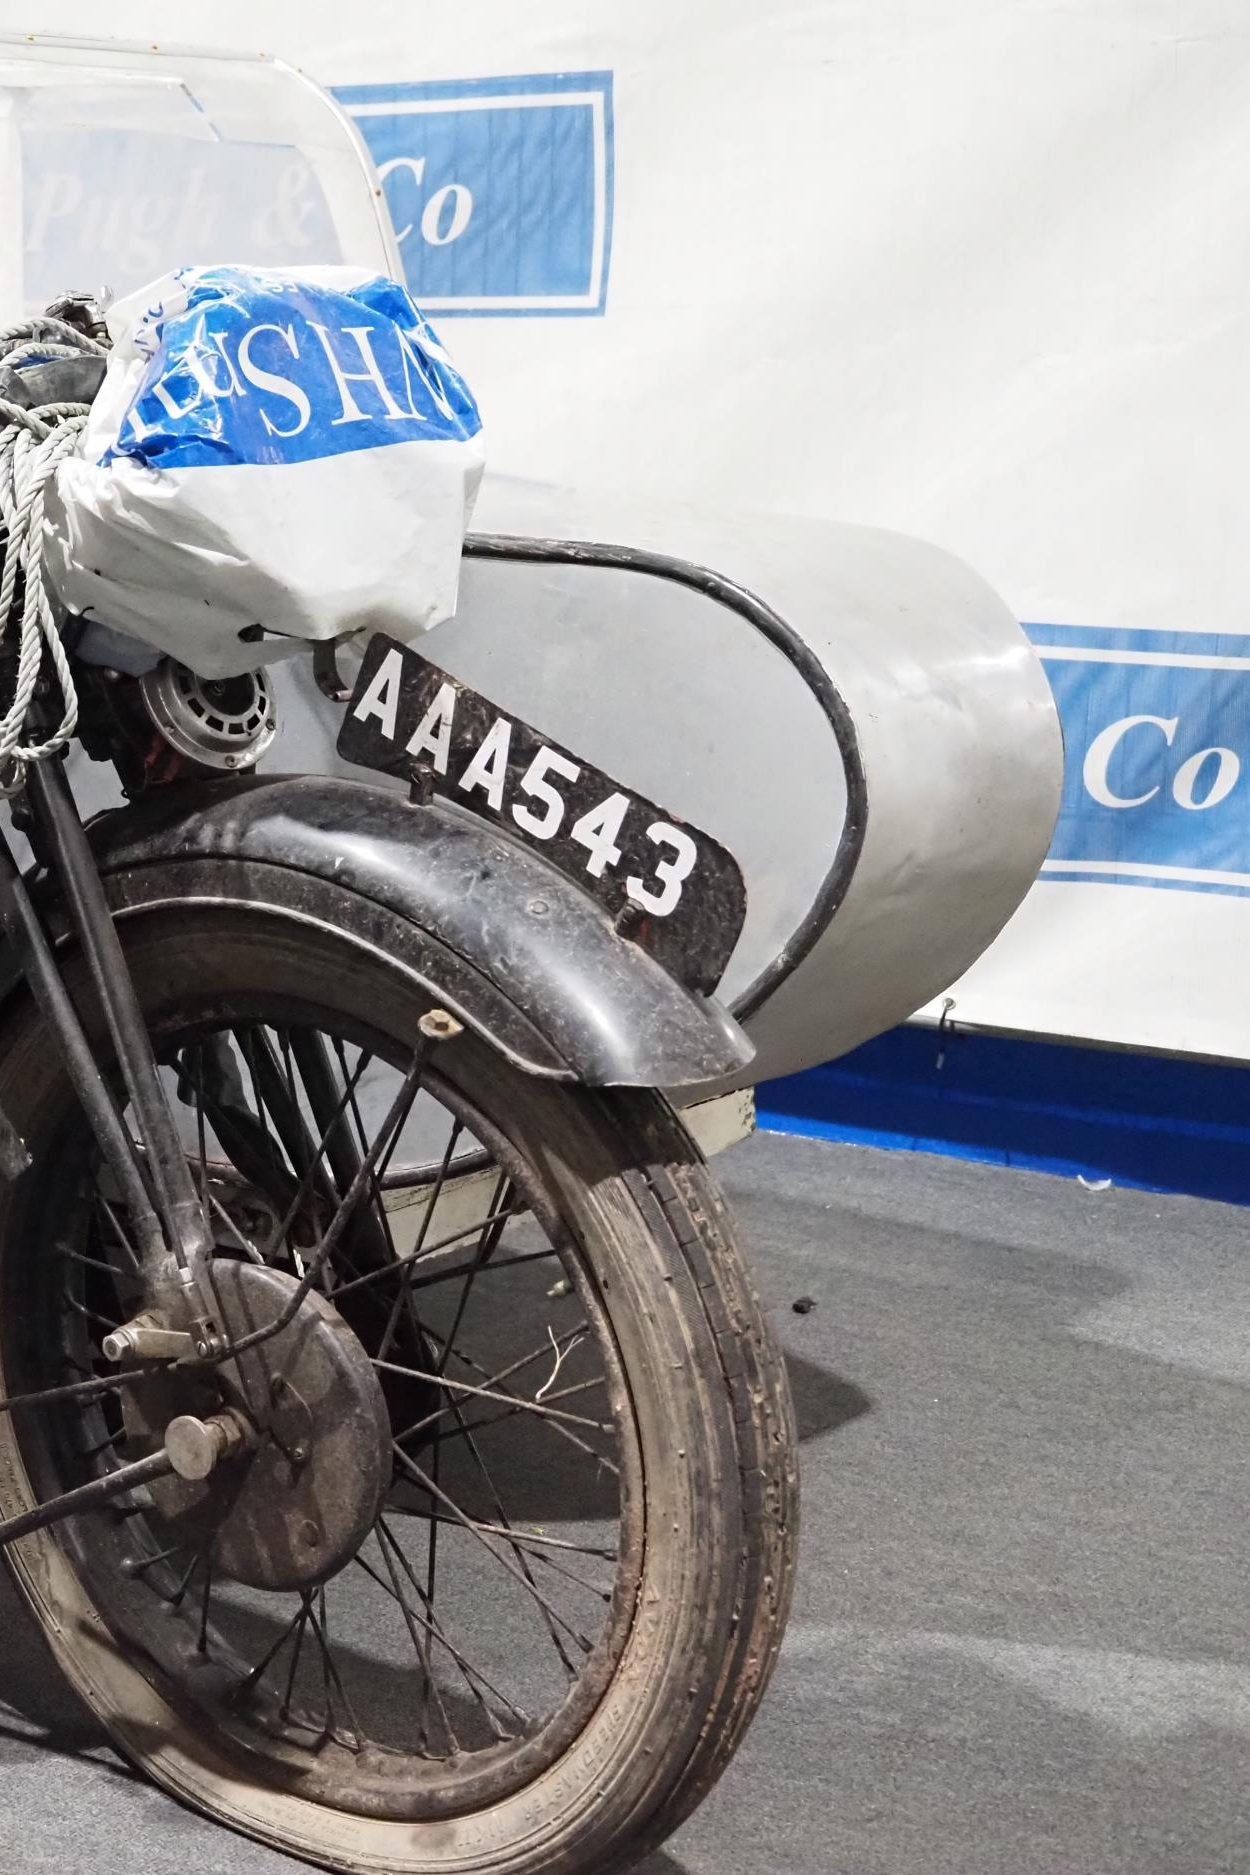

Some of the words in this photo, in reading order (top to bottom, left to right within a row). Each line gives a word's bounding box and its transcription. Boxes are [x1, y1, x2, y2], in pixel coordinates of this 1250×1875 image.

[374, 157, 473, 246] Co
[353, 648, 698, 917] AAA543
[1083, 714, 1241, 811] Co
